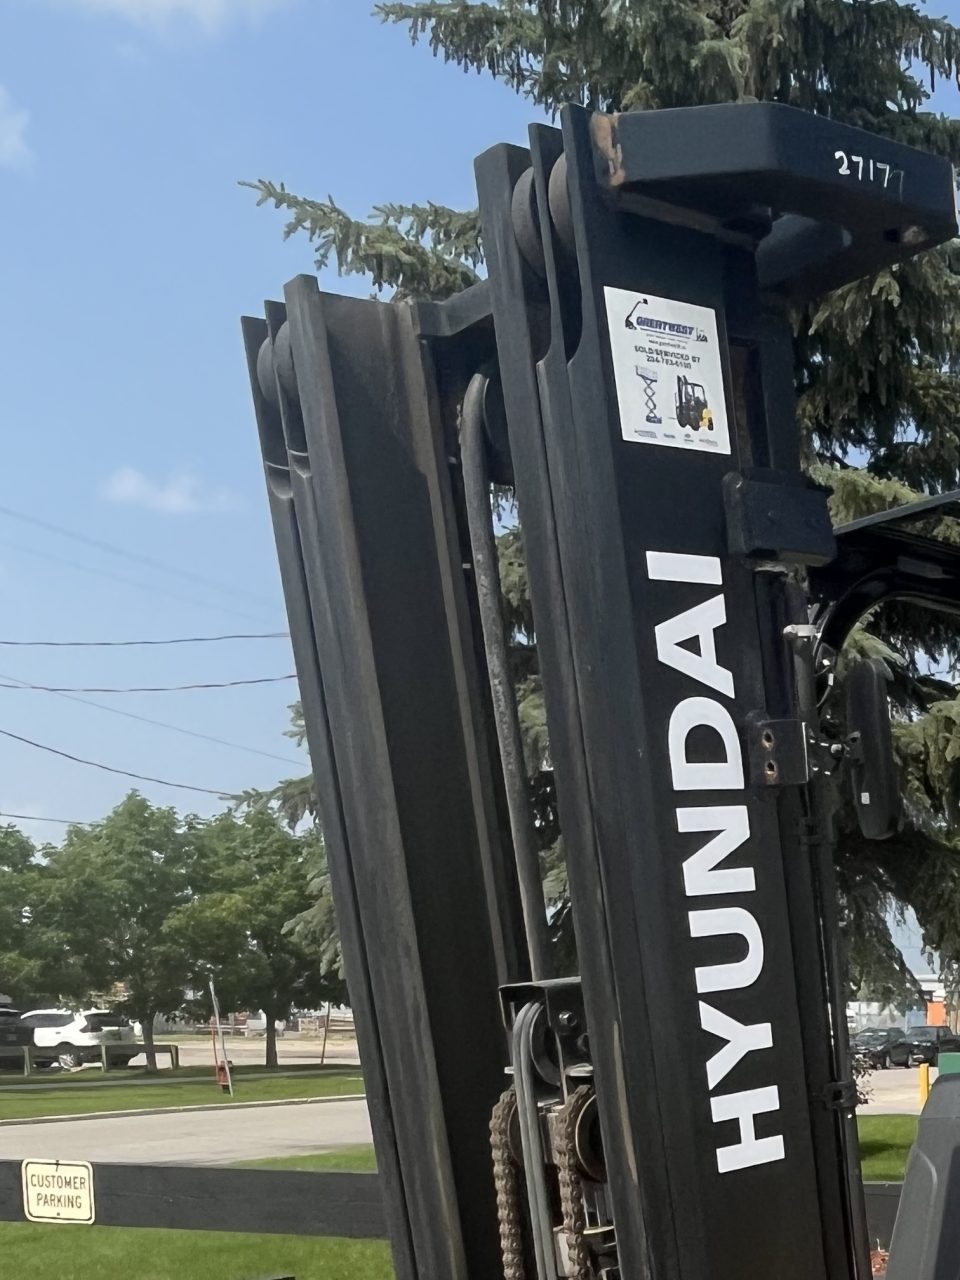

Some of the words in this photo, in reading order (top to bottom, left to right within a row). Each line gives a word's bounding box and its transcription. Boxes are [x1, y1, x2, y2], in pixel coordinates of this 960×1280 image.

[645, 550, 786, 1174] HYUNDAI
[30, 1174, 87, 1190] CUSTOMER
[36, 1192, 82, 1209] PARKING
